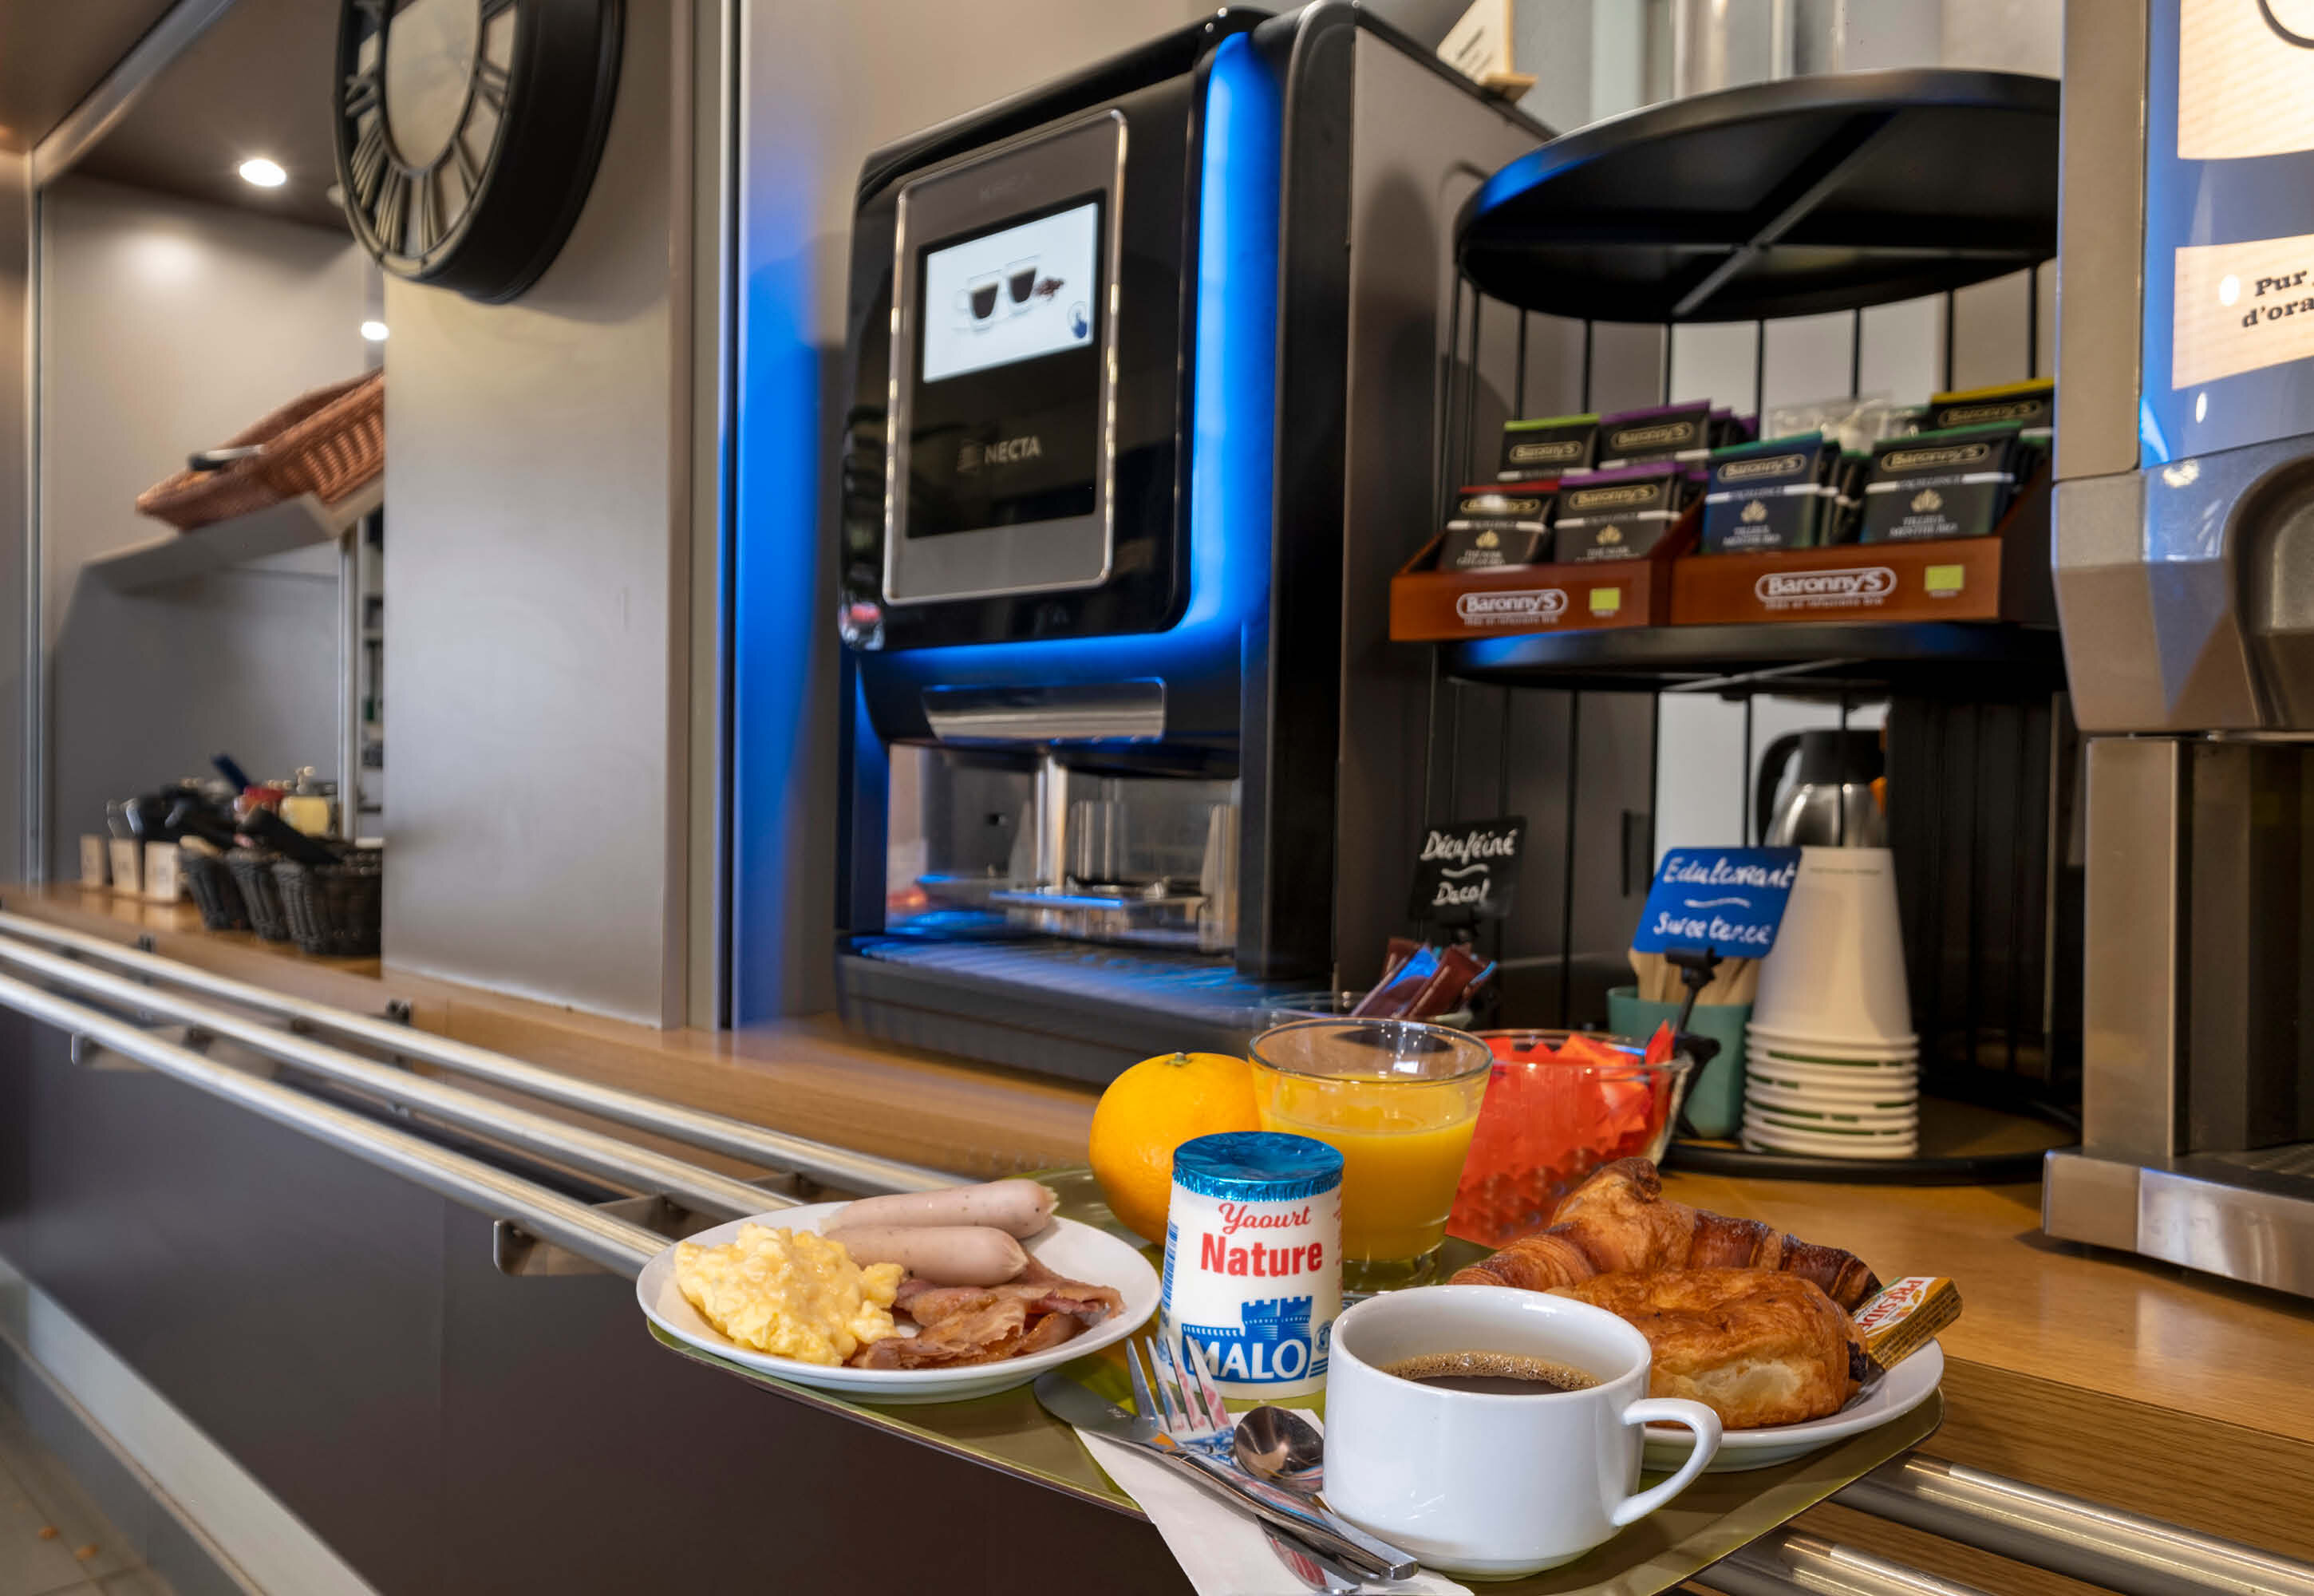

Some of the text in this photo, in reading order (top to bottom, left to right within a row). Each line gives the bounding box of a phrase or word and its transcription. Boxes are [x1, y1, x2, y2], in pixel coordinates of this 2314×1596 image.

[2254, 270, 2307, 297] Pur
[984, 435, 1041, 464] NECTA
[1218, 1202, 1312, 1235] Yaourt
[1200, 1232, 1323, 1278] Nature
[1188, 1338, 1308, 1380] MALO
